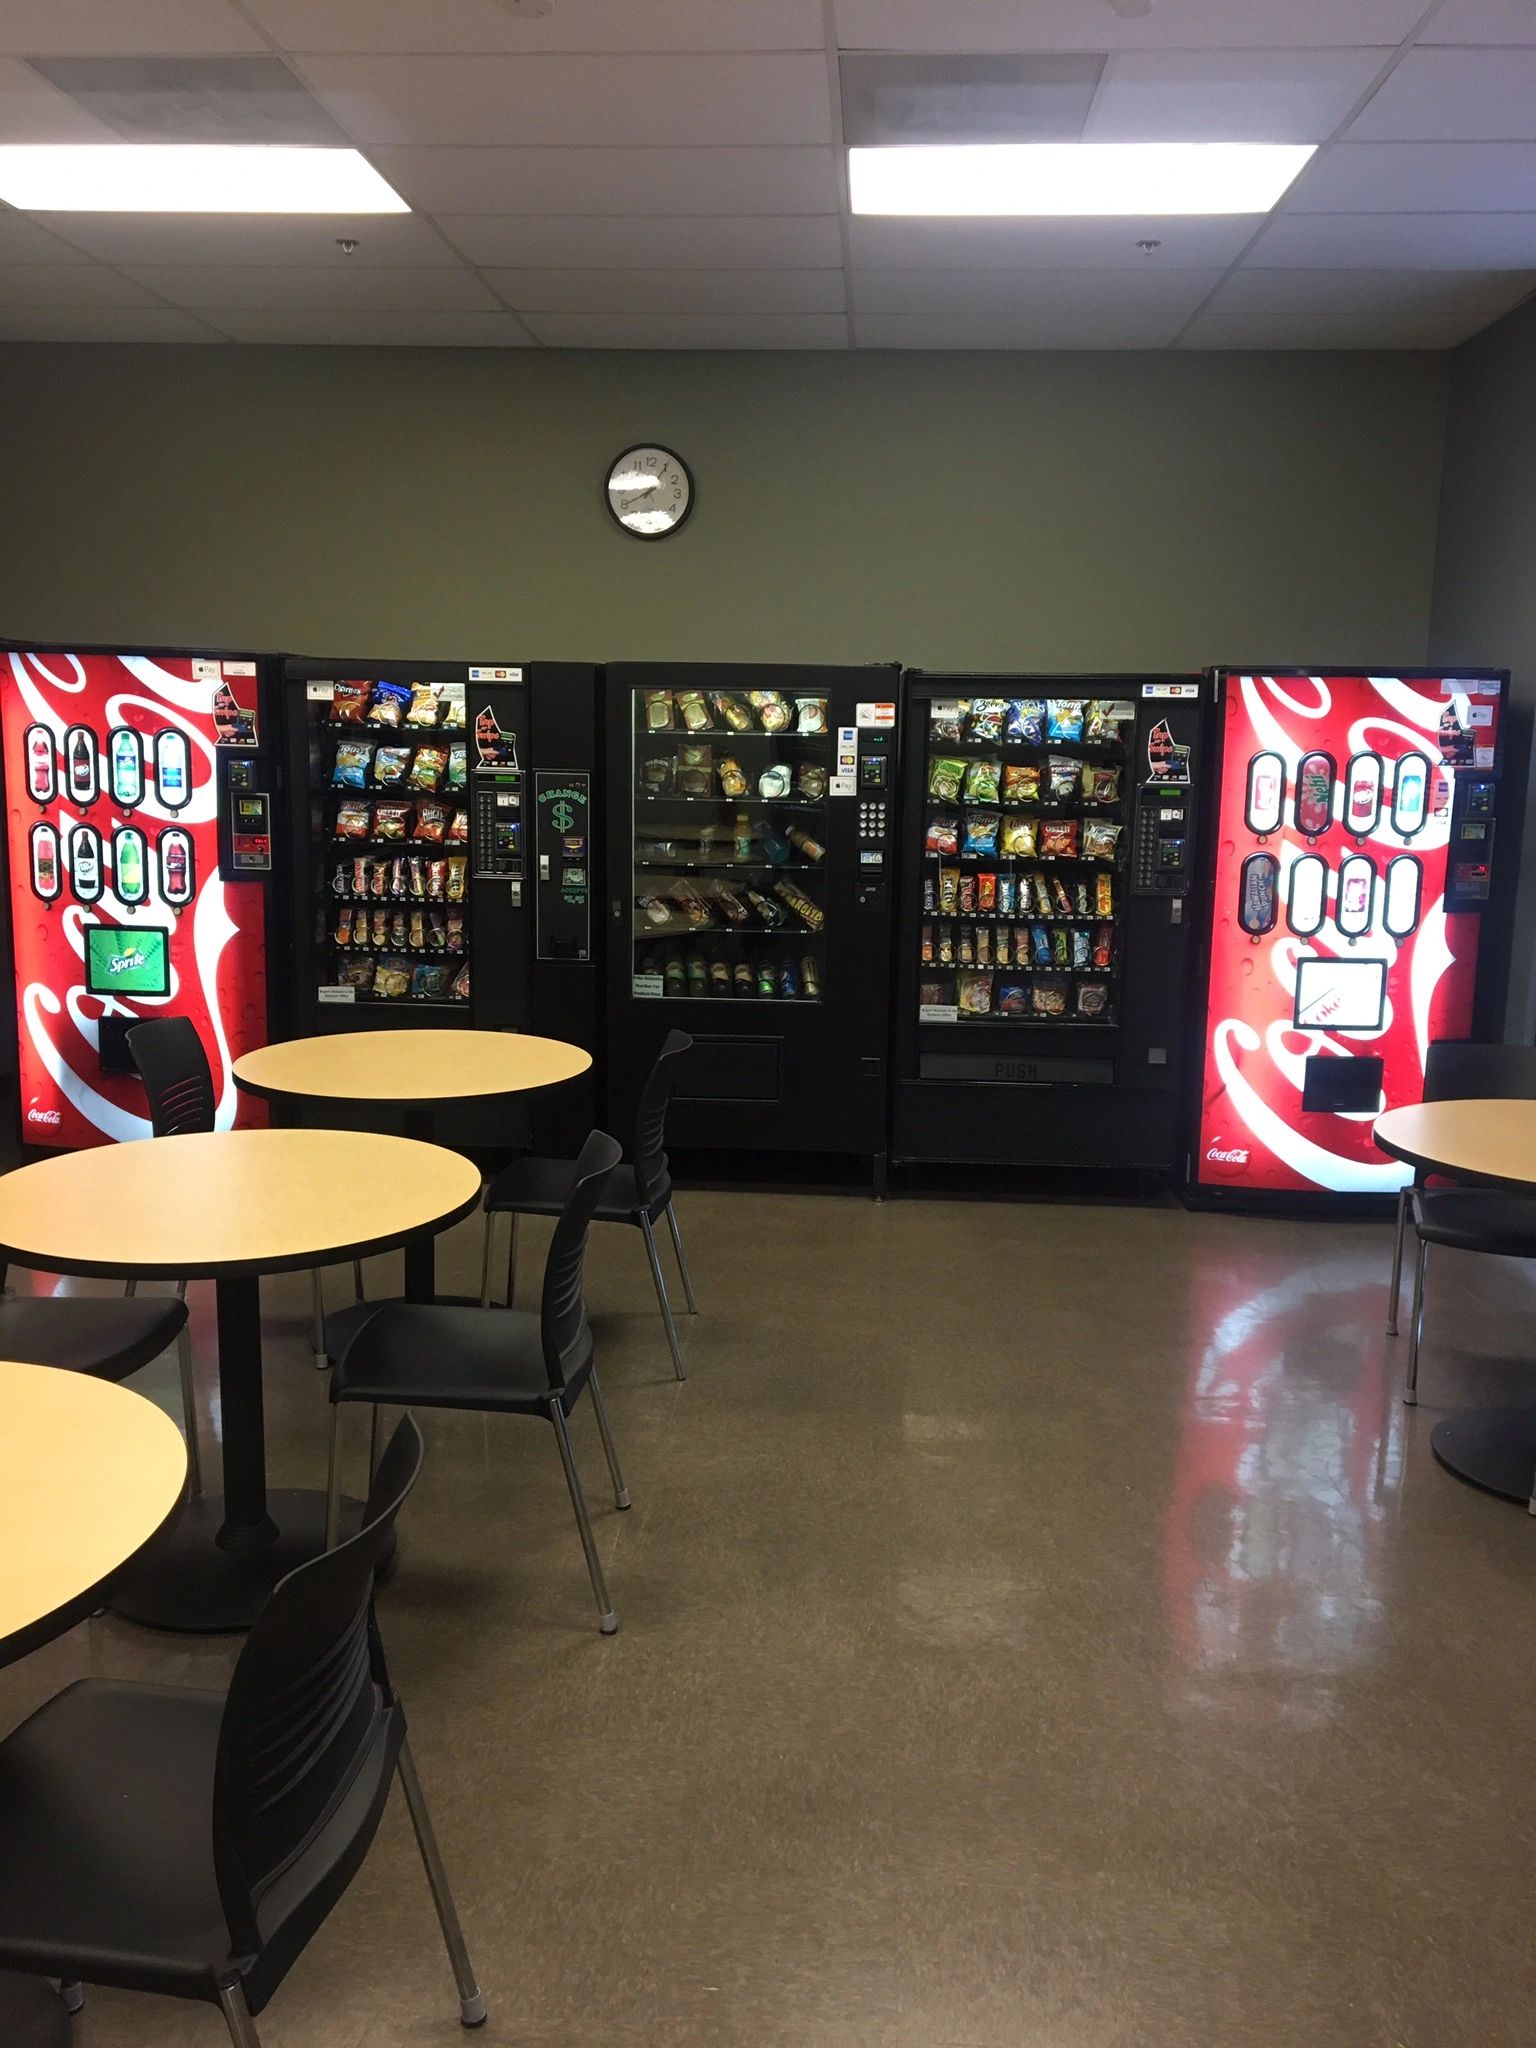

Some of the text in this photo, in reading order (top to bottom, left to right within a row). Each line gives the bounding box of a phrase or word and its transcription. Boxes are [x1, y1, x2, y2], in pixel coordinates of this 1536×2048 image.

[645, 457, 657, 467] 12
[671, 475, 679, 485] 2
[674, 489, 682, 499] 3
[620, 499, 629, 510] 8
[669, 503, 676, 513] 4
[538, 789, 588, 805] CHANGE
[1305, 775, 1329, 803] Nehi
[1250, 873, 1263, 911] HAWAIIAN
[1258, 880, 1269, 906] PUNCH
[109, 951, 146, 973] Sprite
[994, 1062, 1038, 1080] PUSH
[28, 1108, 61, 1124] Coca-Cola
[1207, 1148, 1250, 1163] Coca-Cola
